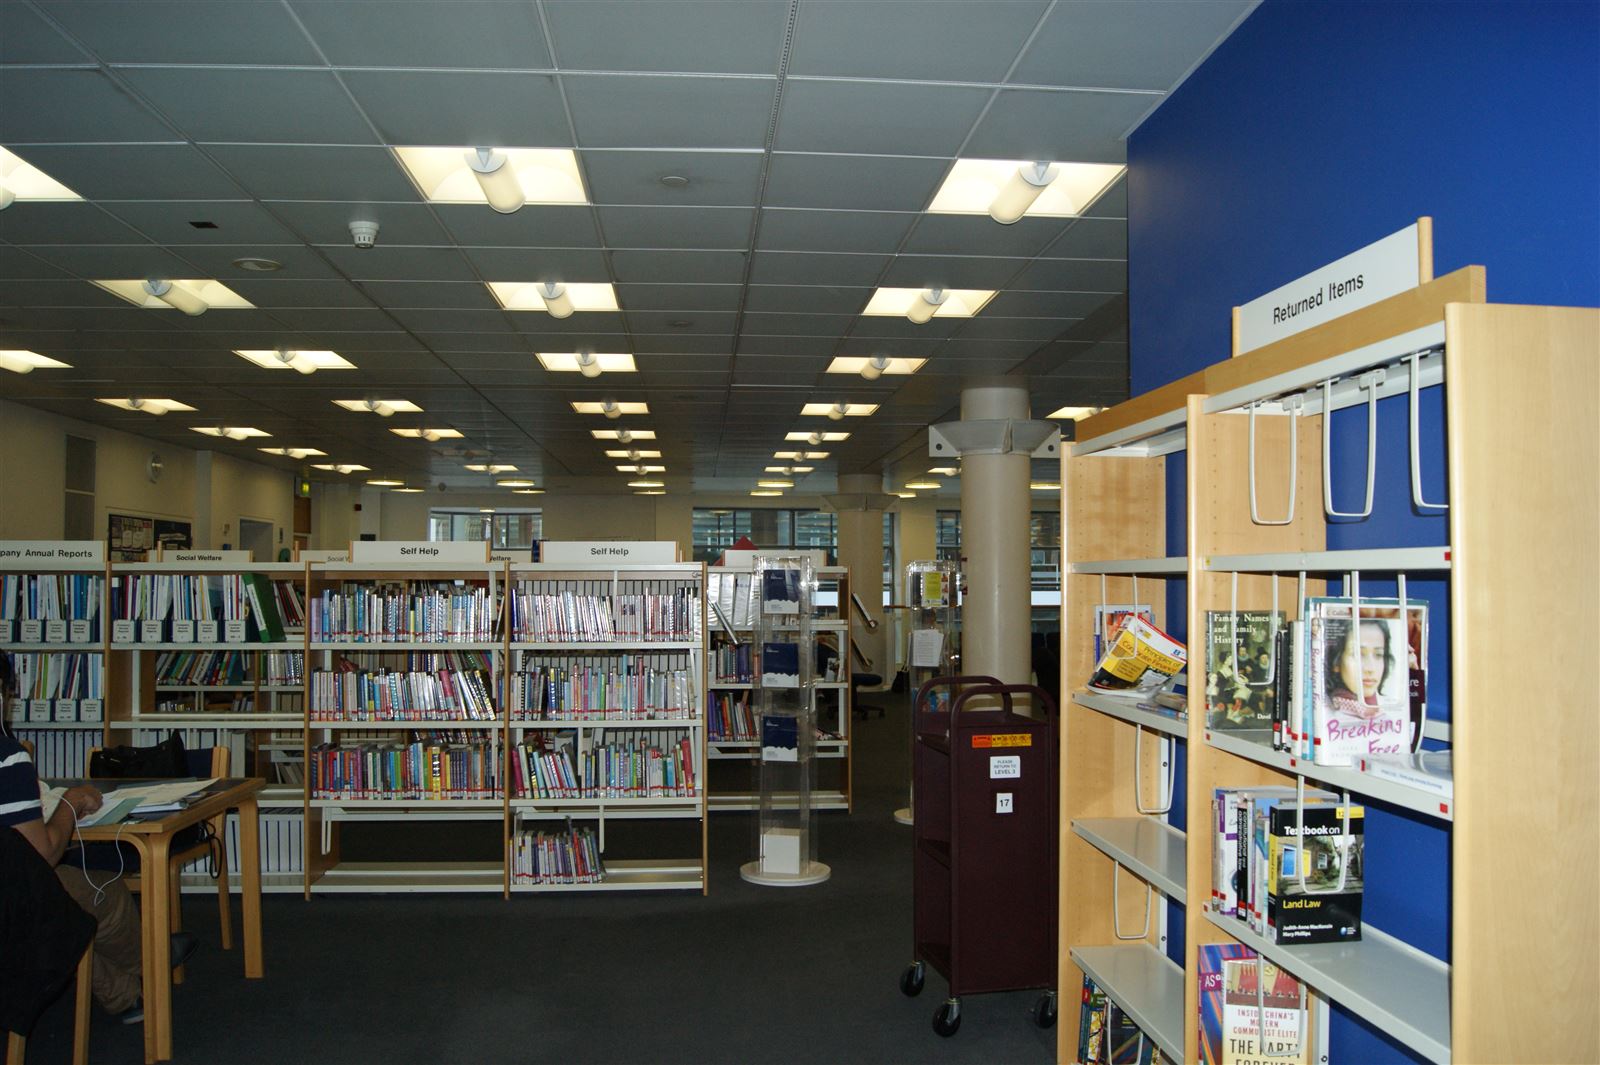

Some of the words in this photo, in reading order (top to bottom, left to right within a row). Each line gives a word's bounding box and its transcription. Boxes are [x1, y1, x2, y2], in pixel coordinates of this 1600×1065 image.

[1273, 287, 1323, 325] Returned
[1328, 274, 1364, 302] Items
[25, 549, 54, 557] Annual
[58, 549, 93, 558] Reports
[400, 547, 417, 555] Self
[419, 547, 439, 556] Help
[590, 547, 607, 555] Self
[609, 547, 629, 557] Help
[1214, 613, 1240, 624] Famy
[1233, 624, 1257, 636] amily
[1214, 635, 1244, 647] Histry
[1327, 718, 1402, 741] Breaking
[1369, 739, 1400, 755] Free
[999, 799, 1010, 808] 17
[1284, 825, 1328, 836] Tebook
[1329, 826, 1340, 835] on
[1283, 900, 1303, 909] Land
[1304, 900, 1321, 909] Law
[1205, 974, 1215, 987] AS
[1238, 1009, 1260, 1018] INSID
[1265, 1011, 1294, 1020] CHINA'S
[1250, 1018, 1279, 1028] MOERN
[1233, 1026, 1275, 1037] COMMUIST
[1230, 1039, 1253, 1055] THE
